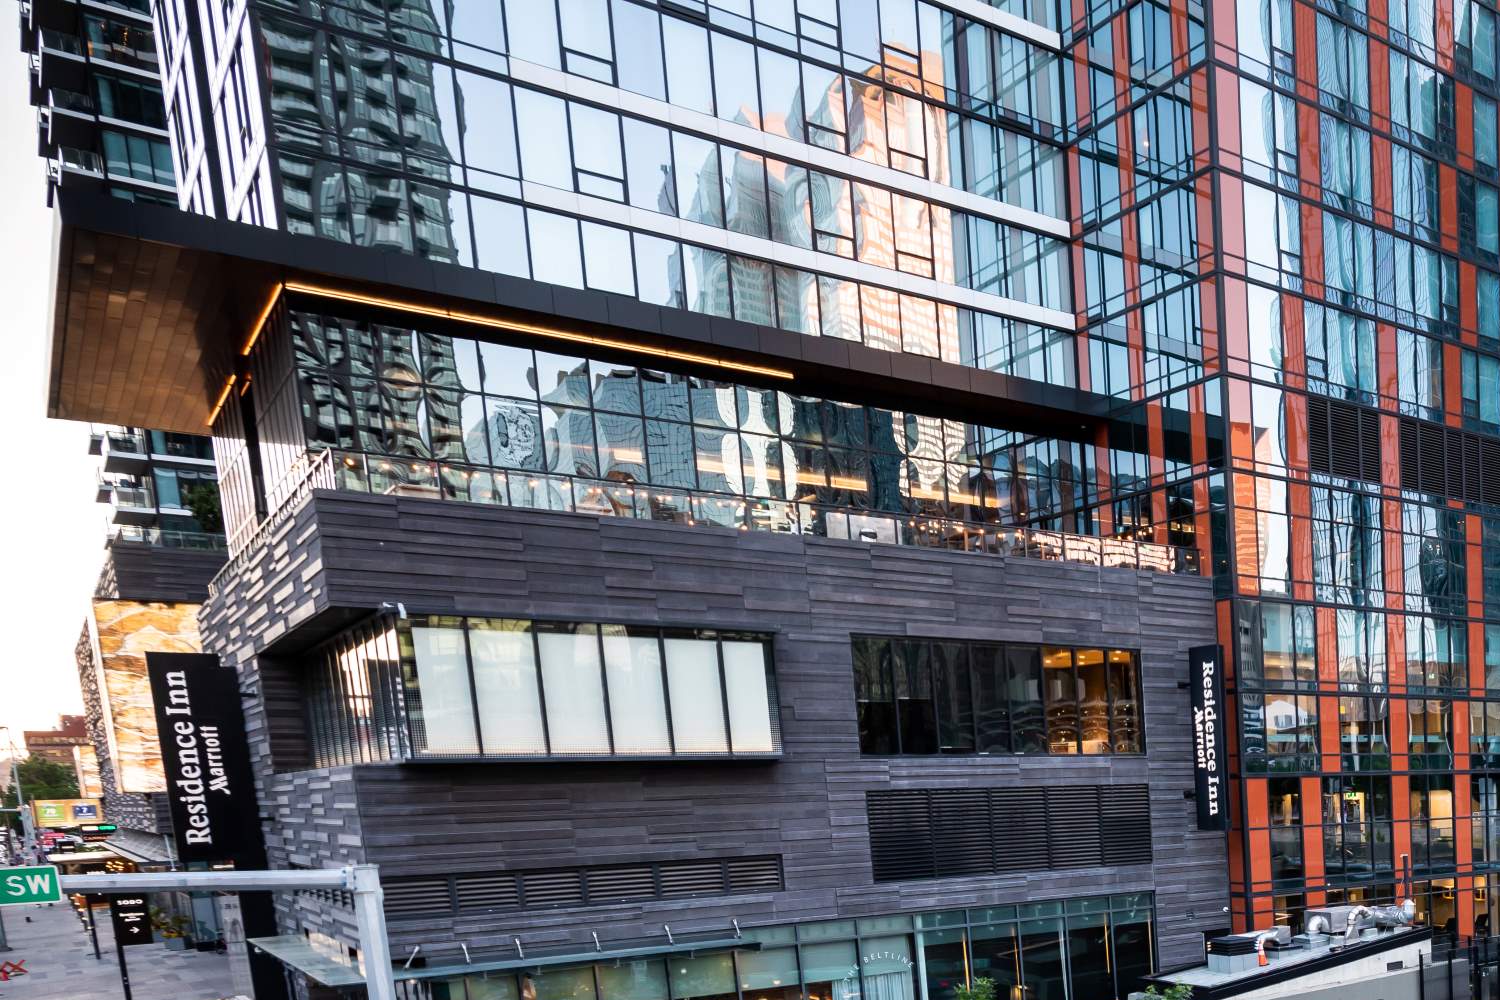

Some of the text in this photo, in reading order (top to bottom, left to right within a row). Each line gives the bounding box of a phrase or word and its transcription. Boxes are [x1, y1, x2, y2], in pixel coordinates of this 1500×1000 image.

[165, 669, 213, 846] Residence Inn
[199, 725, 232, 795] Marriott
[1194, 706, 1207, 769] Marriott
[1202, 661, 1219, 816] Residence Inn
[6, 873, 50, 896] SW
[863, 951, 914, 968] BELTLINE
